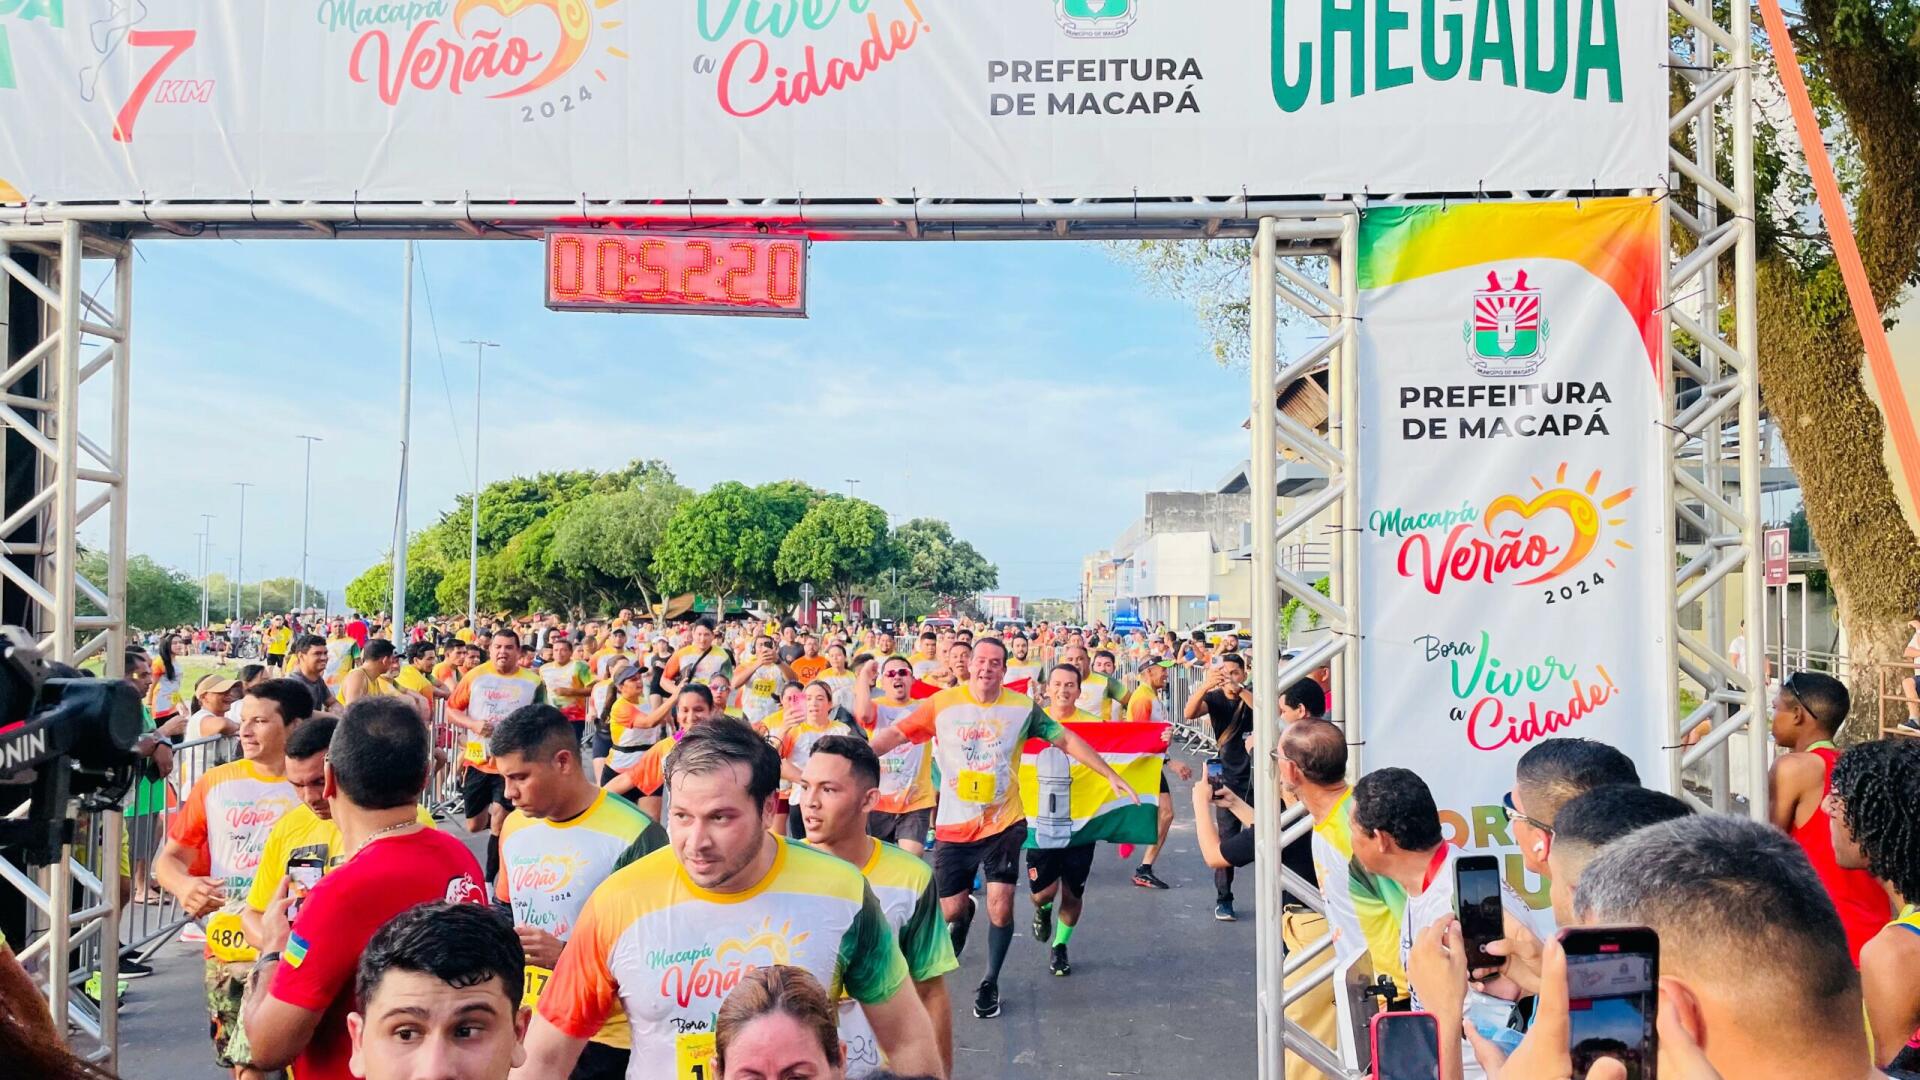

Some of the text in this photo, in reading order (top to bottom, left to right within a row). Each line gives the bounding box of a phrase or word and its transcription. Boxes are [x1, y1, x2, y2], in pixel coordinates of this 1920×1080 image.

[349, 20, 543, 106] Verão
[693, 0, 931, 118] a Cidade!
[988, 57, 1204, 83] PREFEITURA
[1271, 0, 1624, 113] CHEGADA
[112, 30, 215, 143] 7 KM
[520, 85, 593, 123] 2024
[990, 84, 1201, 116] DE MACAPÁ
[554, 237, 798, 303] 00:52:20
[1400, 382, 1612, 408] PREFEITURA
[1403, 407, 1610, 440] DE MACAPÁ
[1369, 500, 1479, 538] Macapá
[1397, 523, 1560, 595] Verão
[1544, 572, 1604, 604] 2024
[1413, 634, 1476, 662] Bora
[1450, 630, 1576, 699] Viver
[1449, 664, 1620, 751] a Cidade!
[513, 864, 557, 892] Verão
[212, 929, 250, 949] 480
[648, 942, 713, 970] Macapá
[671, 1017, 708, 1033] Bora
